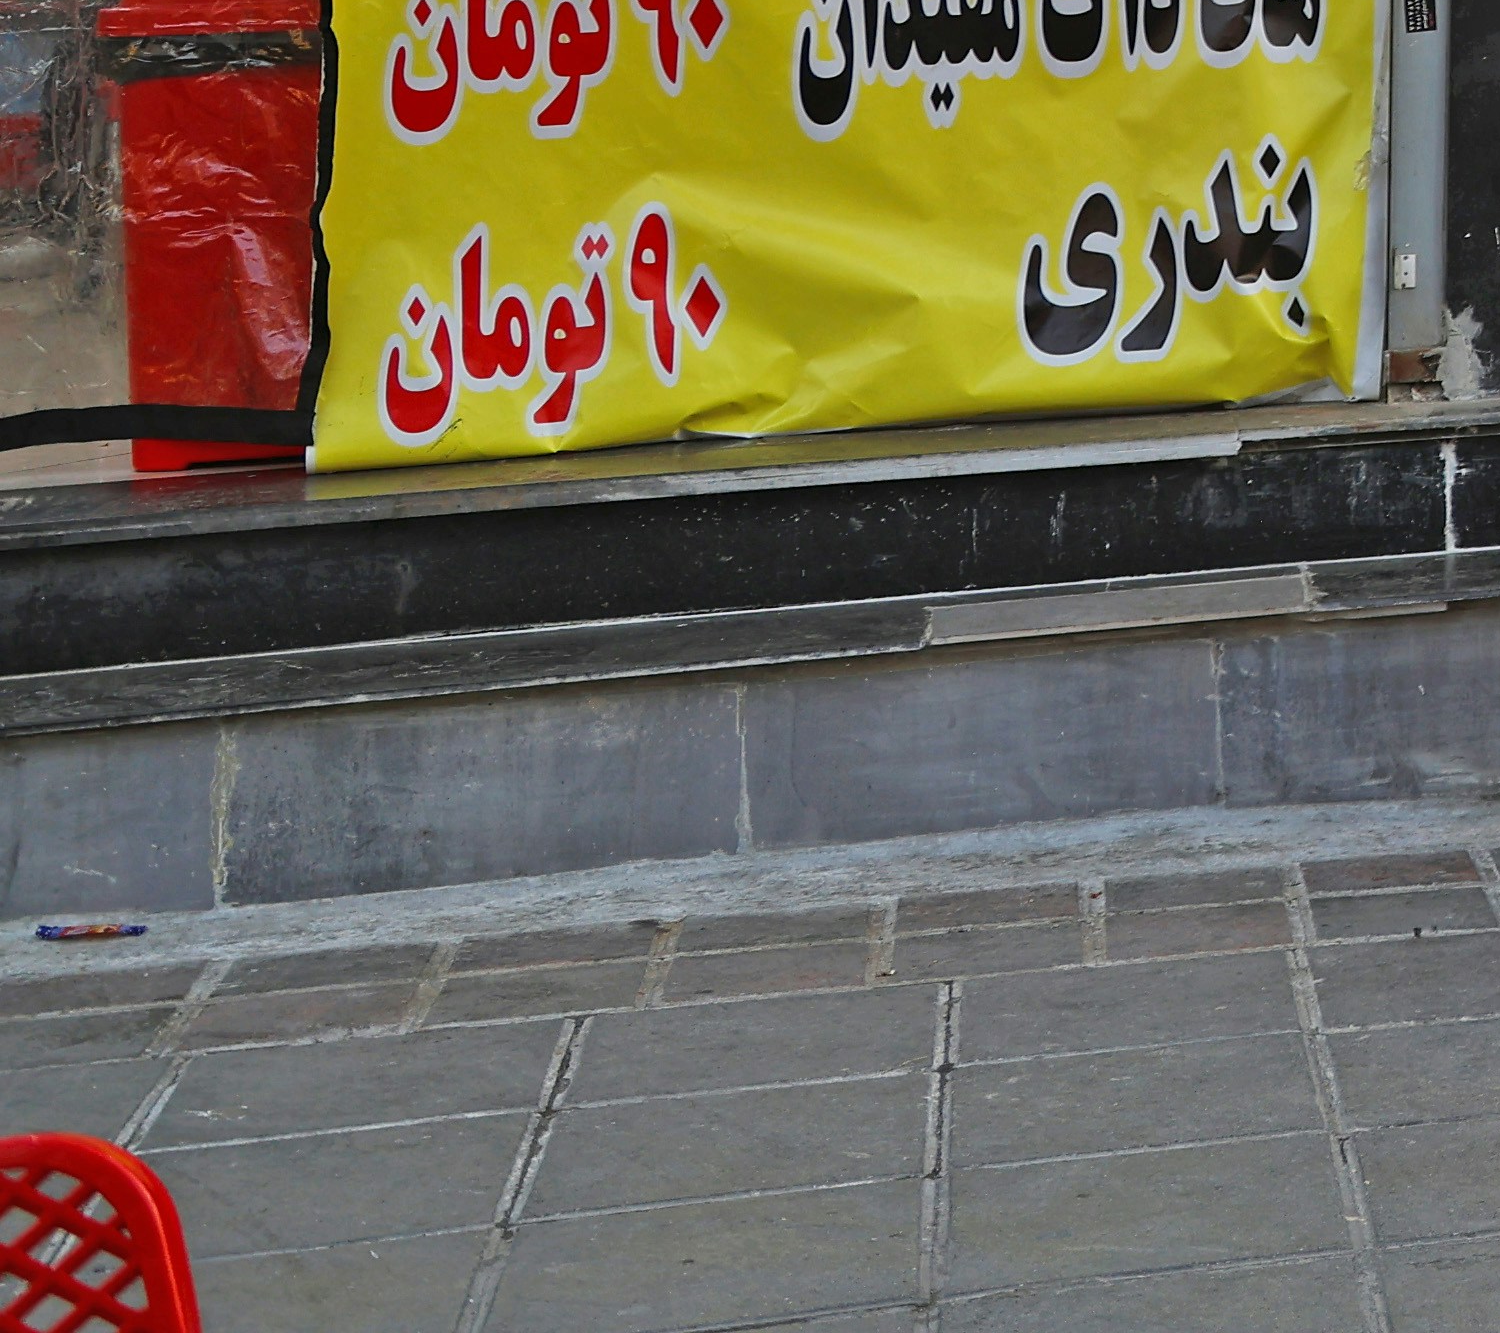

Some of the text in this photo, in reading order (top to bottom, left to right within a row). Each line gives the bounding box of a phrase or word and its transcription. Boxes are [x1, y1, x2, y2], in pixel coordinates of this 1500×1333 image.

[385, 213, 723, 435] ۹۰ تومان
[1024, 145, 1311, 354] بندری
